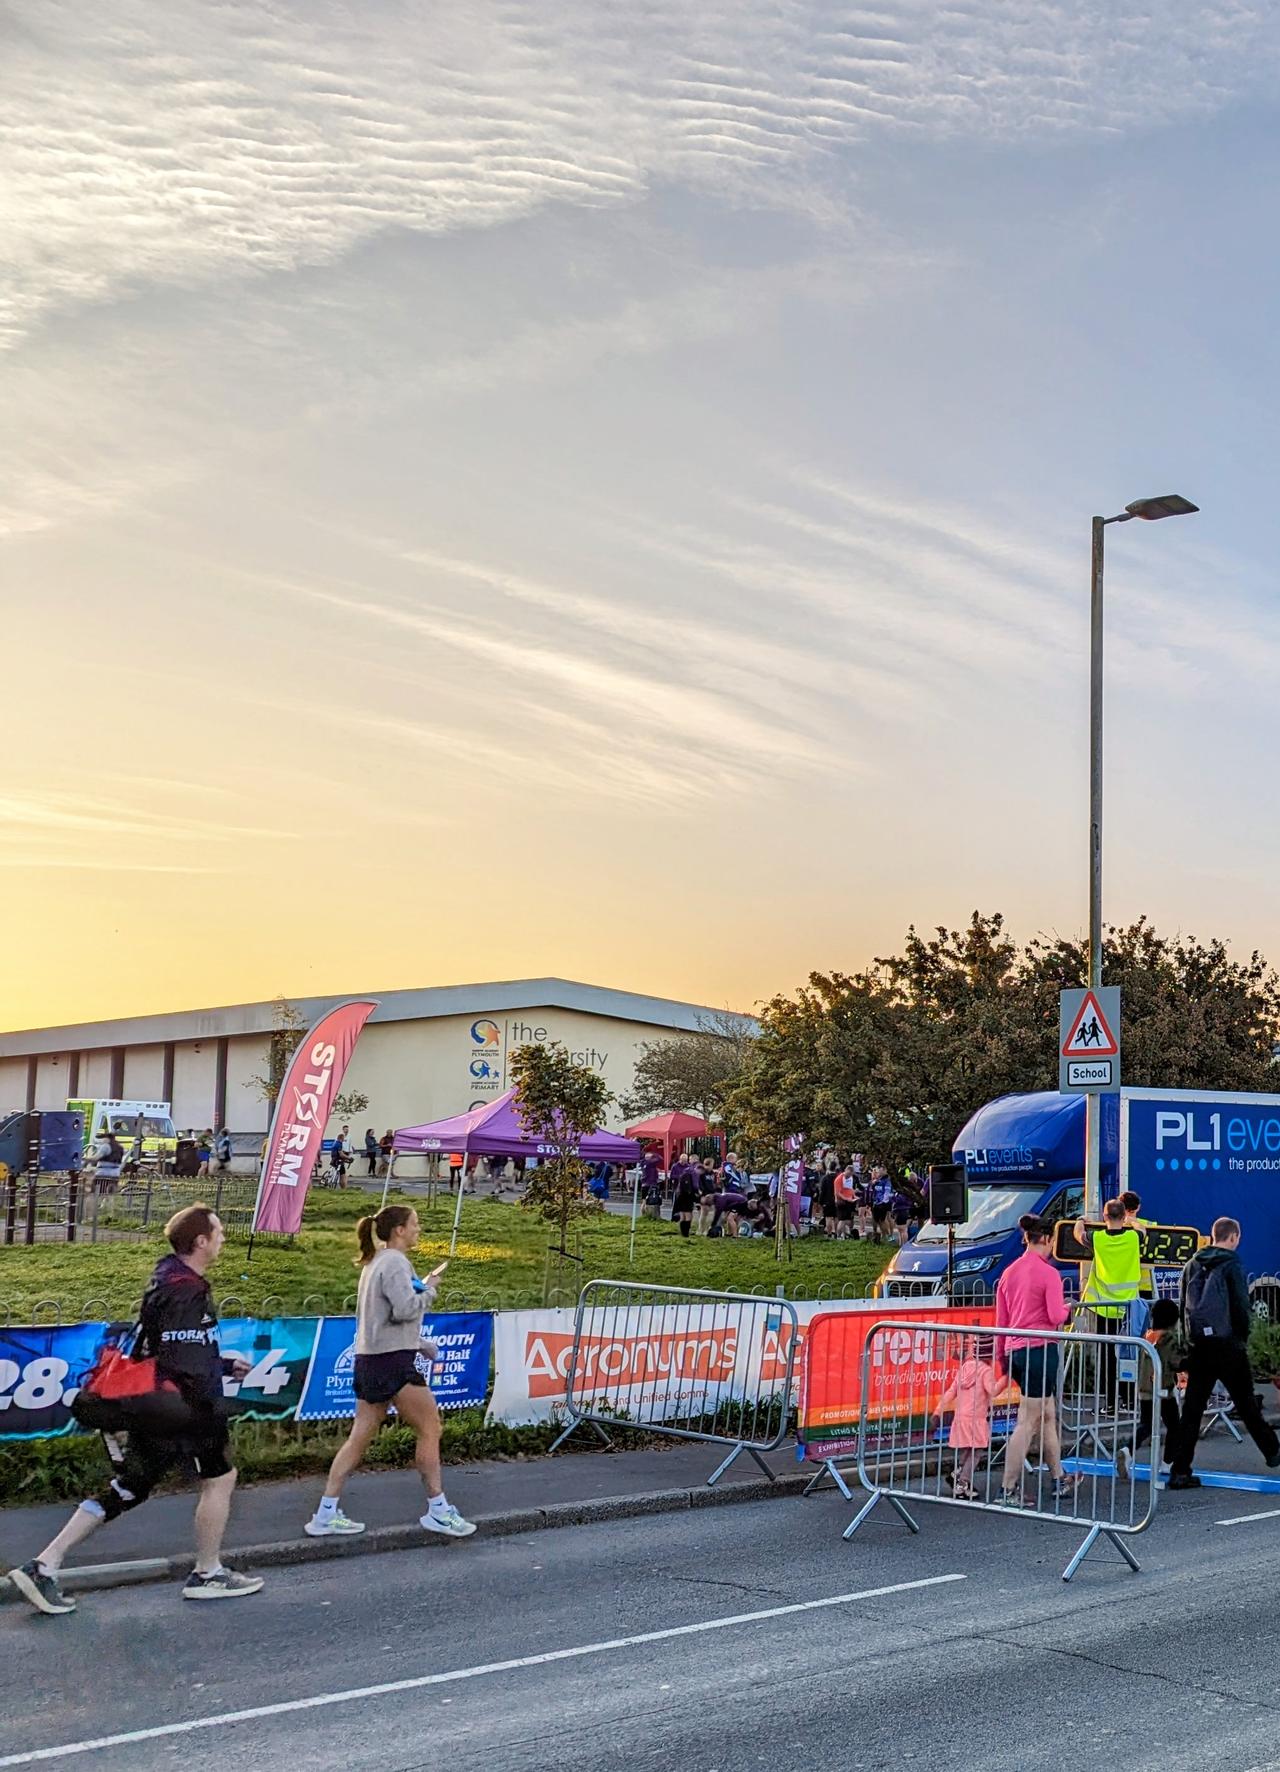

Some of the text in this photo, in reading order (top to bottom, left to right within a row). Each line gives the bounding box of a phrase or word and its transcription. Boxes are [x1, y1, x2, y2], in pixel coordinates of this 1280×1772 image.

[512, 1022, 547, 1041] the
[1073, 1067, 1107, 1079] School
[1156, 1112, 1220, 1150] PL1
[269, 1123, 291, 1185] PLYMOUTH
[965, 1145, 1033, 1164] PL1 events
[1229, 1157, 1244, 1170] the
[424, 1333, 475, 1347] MOUTH
[445, 1348, 471, 1360] Half
[525, 1336, 737, 1380] Acronyms
[444, 1361, 466, 1373] 10k
[443, 1374, 458, 1386] 5k
[923, 1369, 949, 1387] your
[634, 1390, 671, 1404] Unified
[674, 1389, 710, 1400] Comms
[820, 1409, 862, 1420] PROMOTION
[830, 1428, 850, 1436] LITHO
